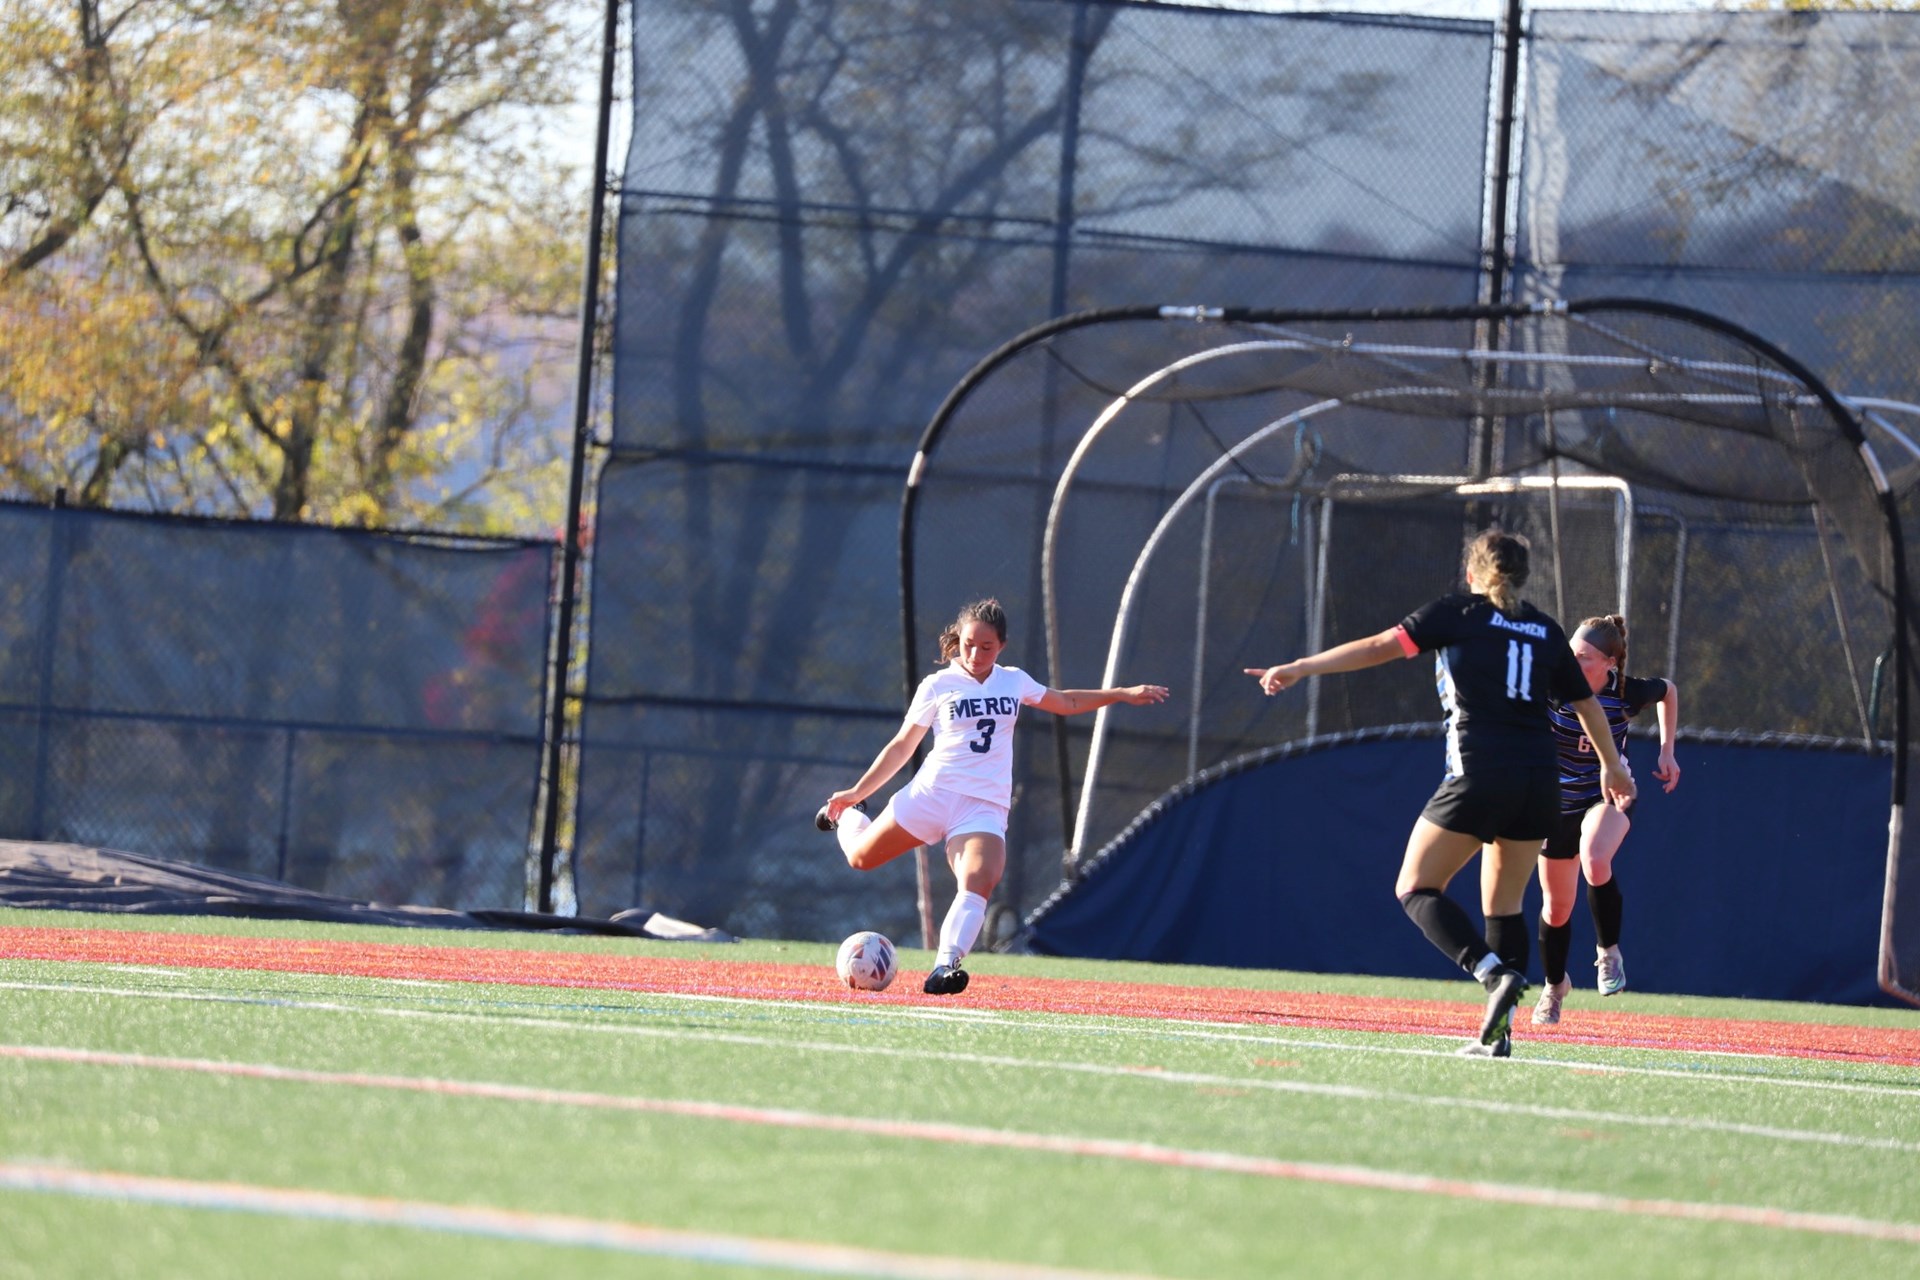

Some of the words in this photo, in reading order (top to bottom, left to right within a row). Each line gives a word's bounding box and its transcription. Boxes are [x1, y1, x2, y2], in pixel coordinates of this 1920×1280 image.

[1507, 639, 1533, 701] 11
[949, 696, 1019, 720] MERCY
[969, 718, 996, 754] 3
